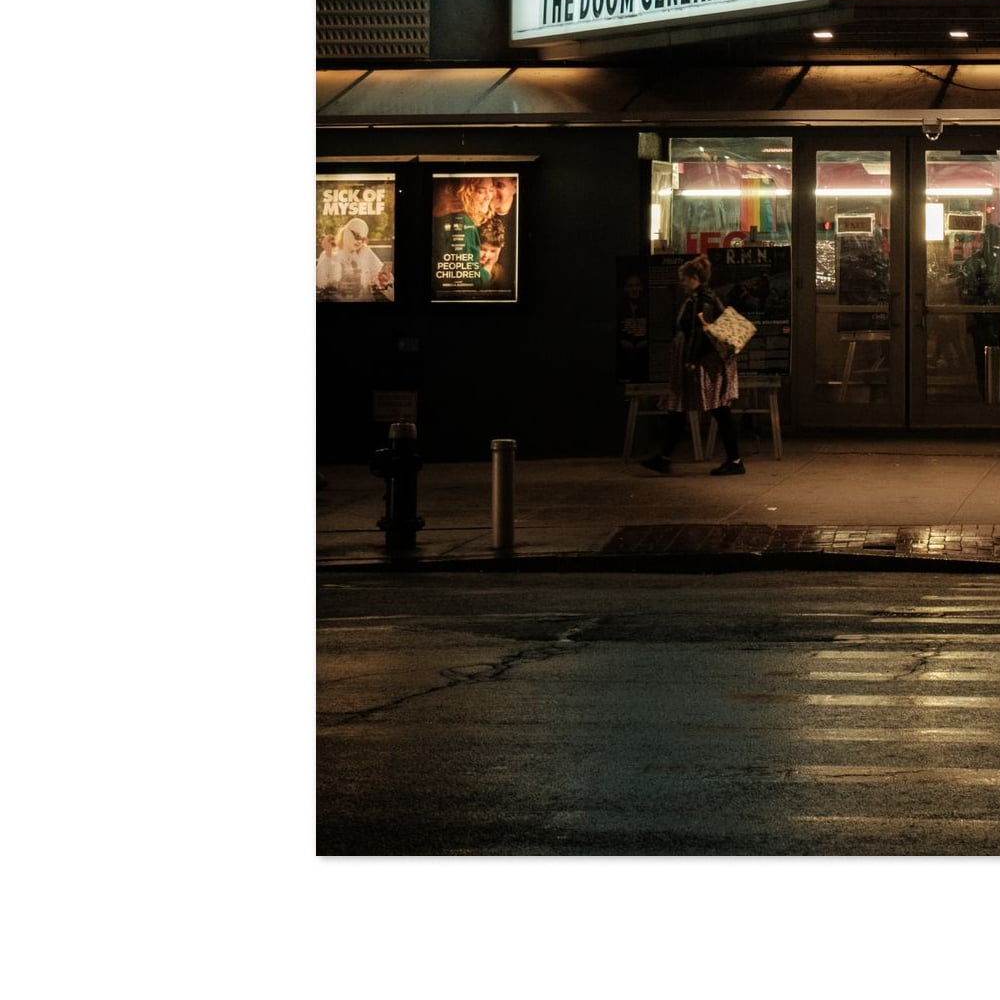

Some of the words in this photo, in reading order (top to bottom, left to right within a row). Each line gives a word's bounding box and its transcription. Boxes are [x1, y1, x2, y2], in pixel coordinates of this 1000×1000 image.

[322, 189, 360, 203] SICK
[362, 189, 385, 203] OF
[322, 202, 385, 216] MYSELF
[443, 253, 474, 262] OTHER
[435, 270, 481, 279] CHILDREN
